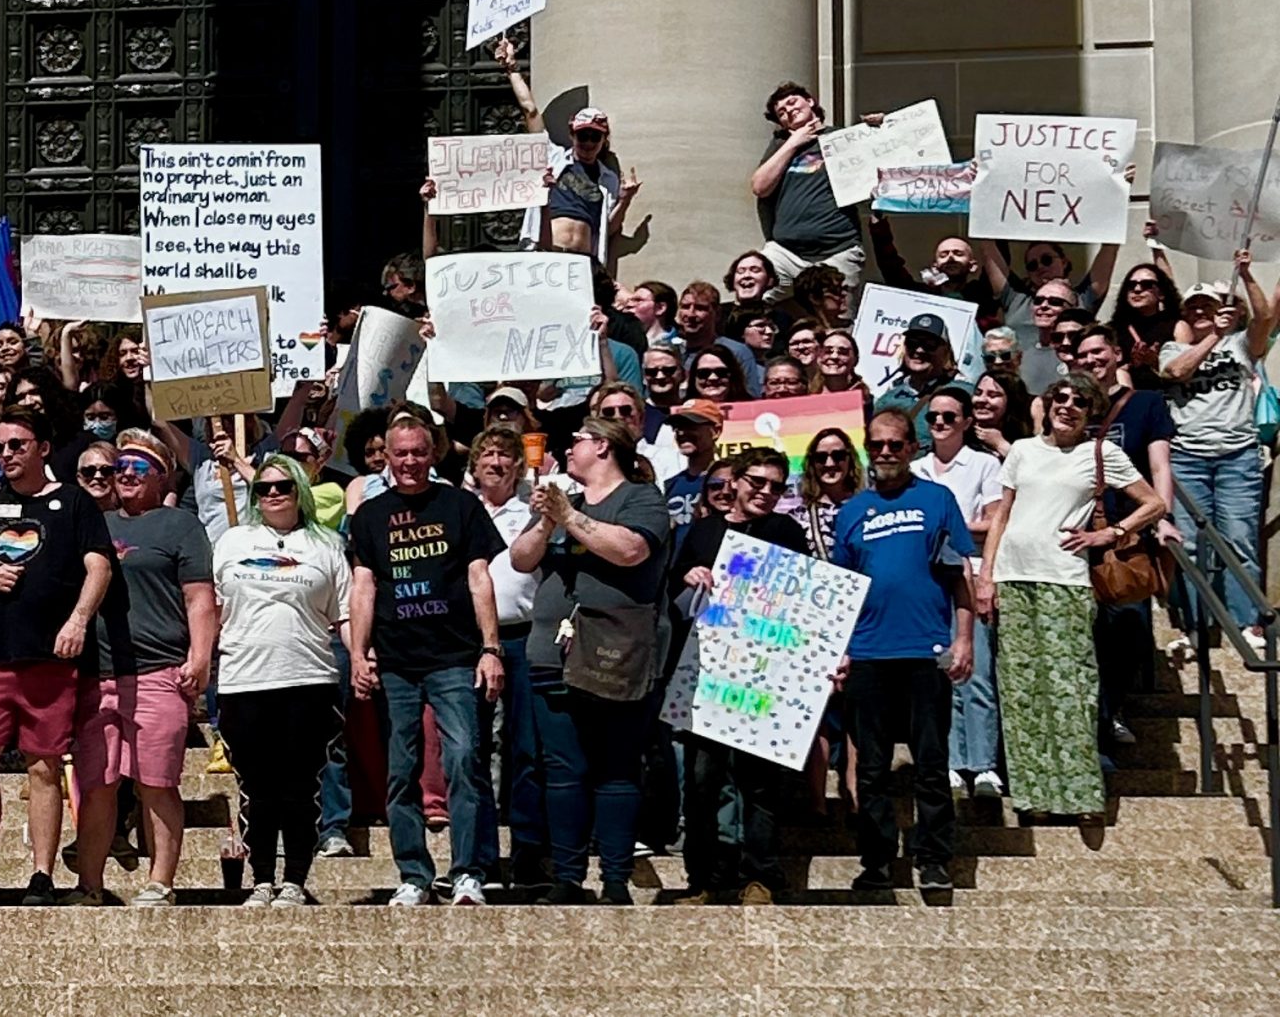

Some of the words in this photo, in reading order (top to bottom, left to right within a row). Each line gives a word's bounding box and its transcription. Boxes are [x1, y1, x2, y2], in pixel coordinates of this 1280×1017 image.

[990, 121, 1118, 151] JUSTICE
[141, 147, 175, 169] This
[178, 152, 214, 169] ain't
[216, 150, 265, 168] comin'
[265, 150, 306, 169] from
[143, 172, 164, 183] no
[166, 169, 239, 191] prophet,
[240, 171, 277, 190] just
[282, 175, 303, 187] an
[1024, 161, 1076, 188] FOR
[142, 188, 210, 209] ordinary
[999, 188, 1084, 227] NEX
[143, 205, 191, 227] When
[195, 207, 200, 228] I
[203, 210, 247, 226] close
[249, 214, 273, 231] my
[275, 213, 316, 231] eyes
[73, 239, 121, 255] RIGHTS
[145, 231, 151, 254] I
[154, 240, 192, 254] see,
[193, 236, 226, 254] the
[228, 241, 262, 259] way
[266, 237, 301, 256] this
[30, 259, 61, 273] ARE
[144, 262, 190, 279] world
[194, 262, 234, 279] shall
[237, 263, 258, 279] be
[432, 261, 584, 298] JUSTICE
[469, 291, 514, 319] FOR
[152, 307, 256, 346] IMPEACH
[276, 334, 297, 351] to
[161, 340, 261, 376] WALTERS
[387, 509, 417, 527] ALL
[862, 509, 926, 533] MOSAIC
[388, 523, 445, 545] PLACES
[389, 540, 449, 562] SHOULD
[392, 565, 413, 580] BE
[394, 581, 432, 600] SAFE
[396, 600, 449, 620] SPACES
